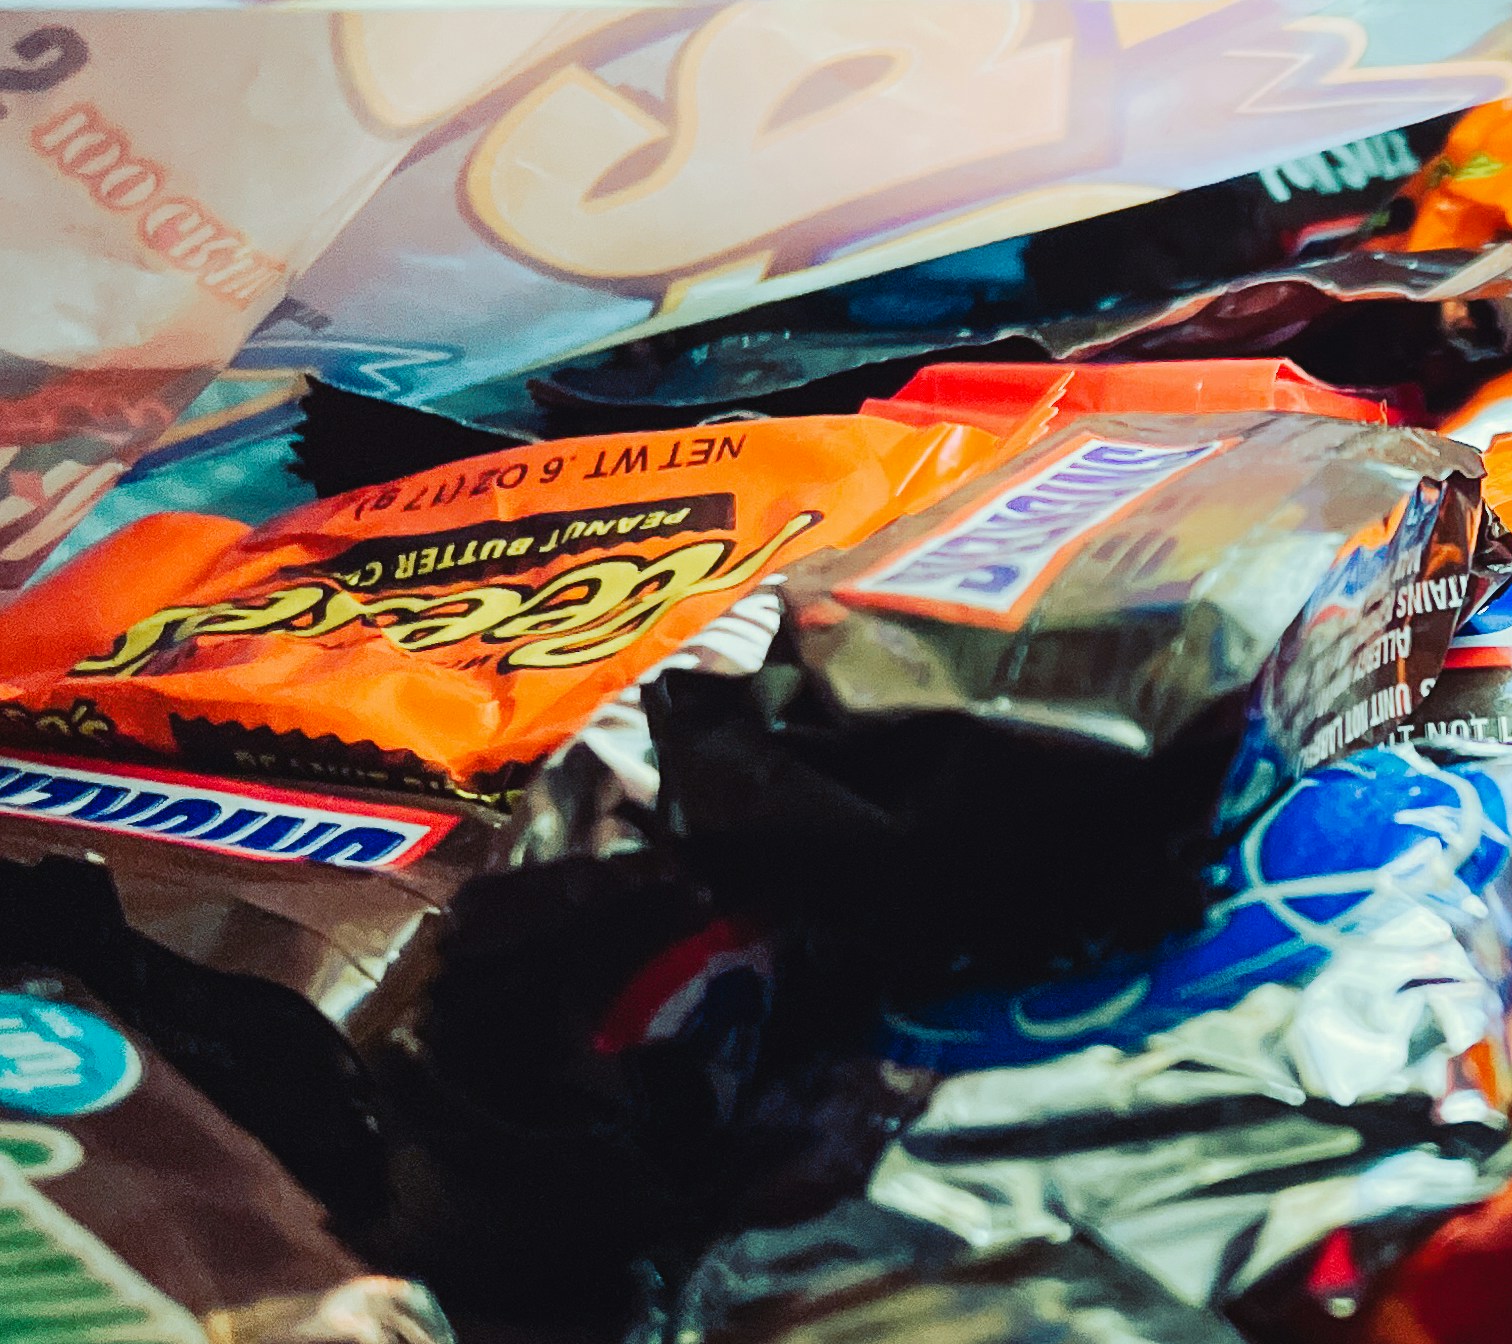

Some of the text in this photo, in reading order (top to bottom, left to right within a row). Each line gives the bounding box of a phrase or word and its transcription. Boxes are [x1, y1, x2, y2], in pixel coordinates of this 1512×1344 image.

[585, 443, 652, 477] WT
[657, 433, 746, 464] NET
[537, 506, 692, 551] PEANUT
[392, 533, 530, 580] BUTTER
